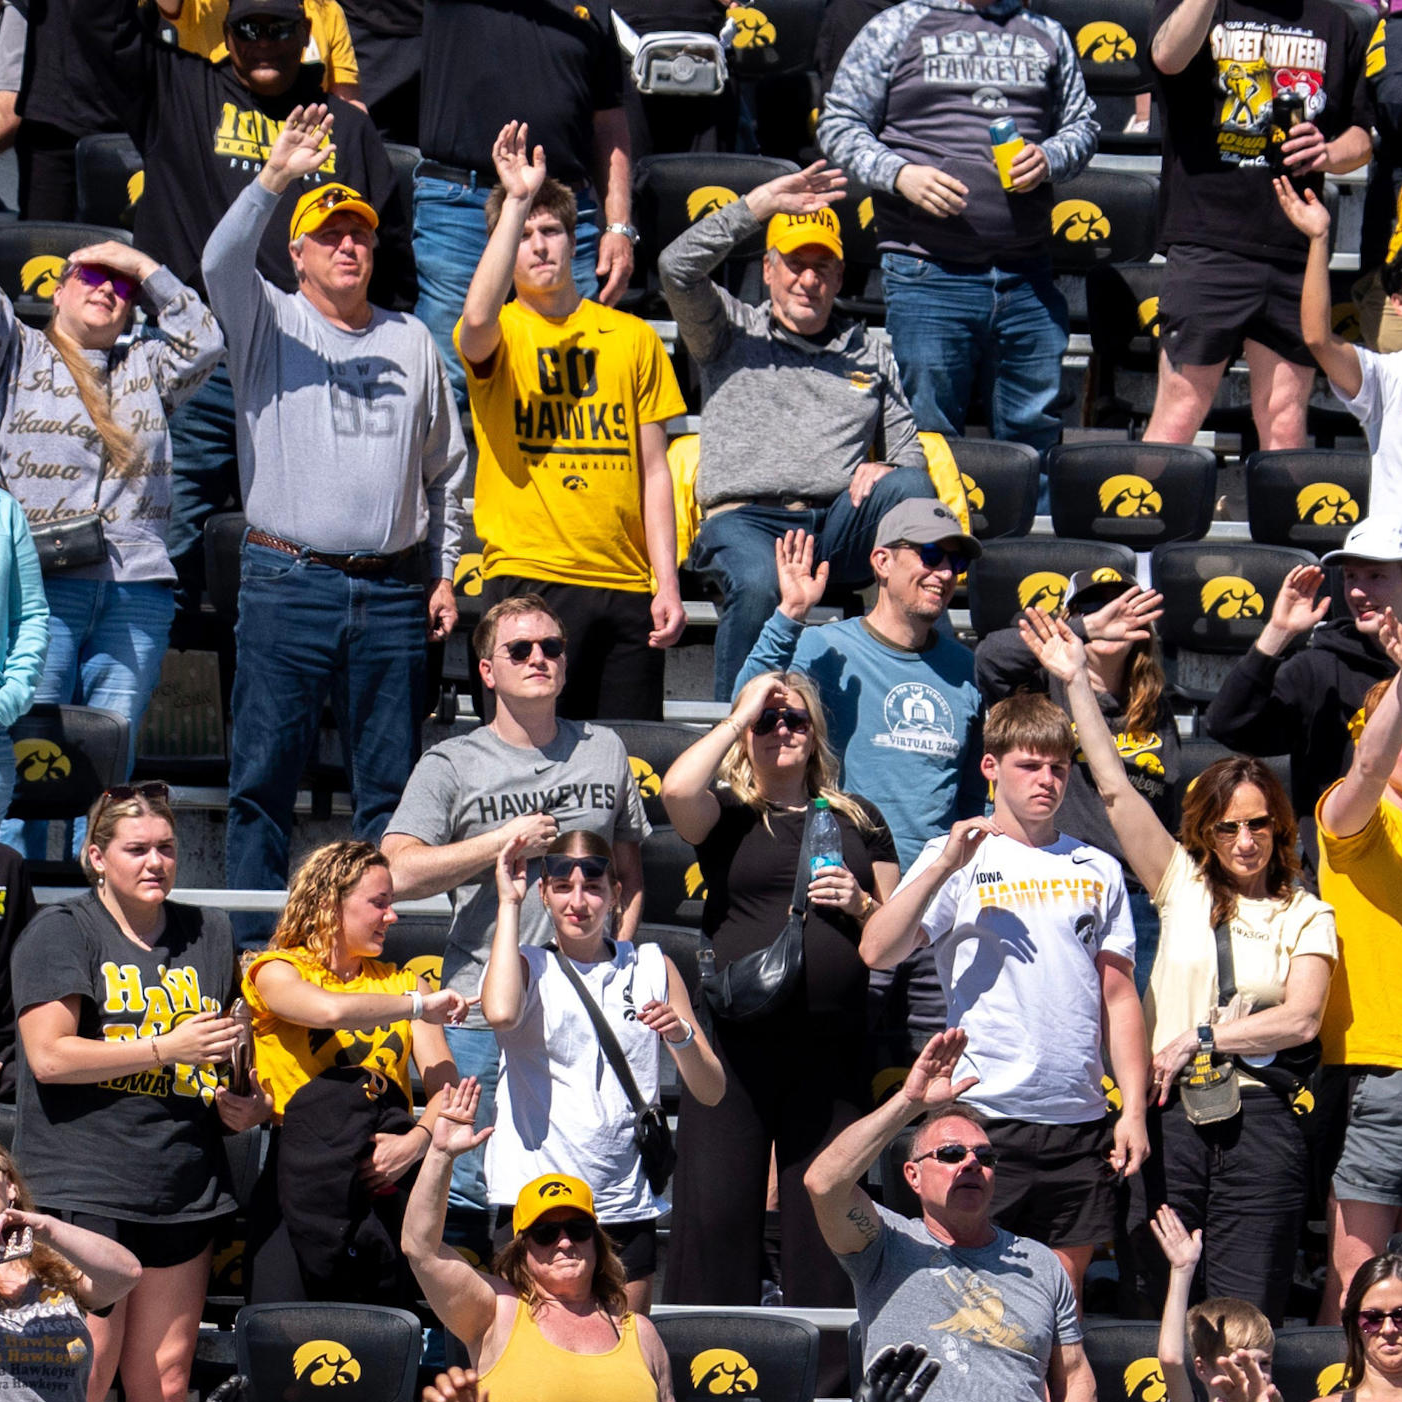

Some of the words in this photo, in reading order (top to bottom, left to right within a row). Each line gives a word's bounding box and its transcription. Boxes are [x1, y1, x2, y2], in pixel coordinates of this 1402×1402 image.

[921, 30, 1048, 58] IOWA
[1211, 24, 1263, 61] SWEET
[1263, 32, 1327, 71] SIXTEEN
[927, 57, 1048, 83] HAWKEYES
[1216, 132, 1268, 149] IOWA
[787, 207, 835, 232] IOWA
[536, 345, 599, 398] GO
[514, 399, 629, 442] HAWKS
[9, 451, 81, 481] Iowa
[889, 734, 934, 750] VIRTUAL
[478, 783, 616, 823] HAWKEYES
[976, 871, 1004, 885] IOWA
[977, 879, 1105, 908] HAWKEYES
[10, 1364, 76, 1379] Hawkeyes
[12, 1378, 69, 1391] Hawkeyes
